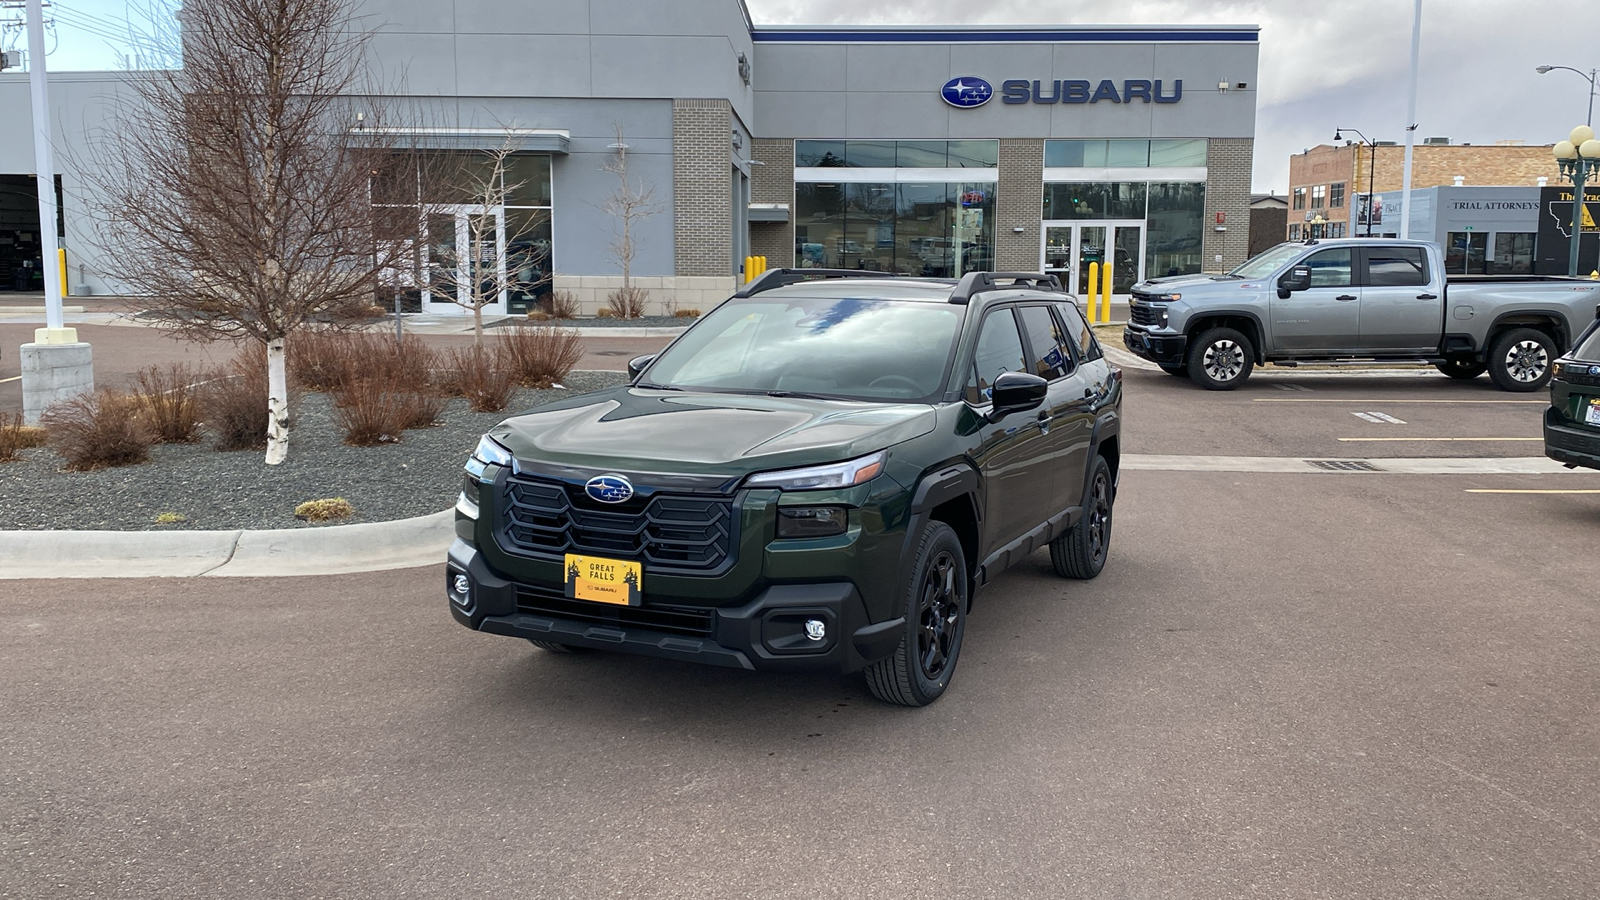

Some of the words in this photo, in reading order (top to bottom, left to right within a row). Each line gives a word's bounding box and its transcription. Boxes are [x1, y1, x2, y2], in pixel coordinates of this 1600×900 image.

[1002, 79, 1183, 104] SUBARU
[1453, 202, 1482, 210] TRIAL
[1484, 202, 1540, 210] ATTORNEYS
[589, 563, 615, 573] GREAT
[589, 571, 615, 581] FALLS
